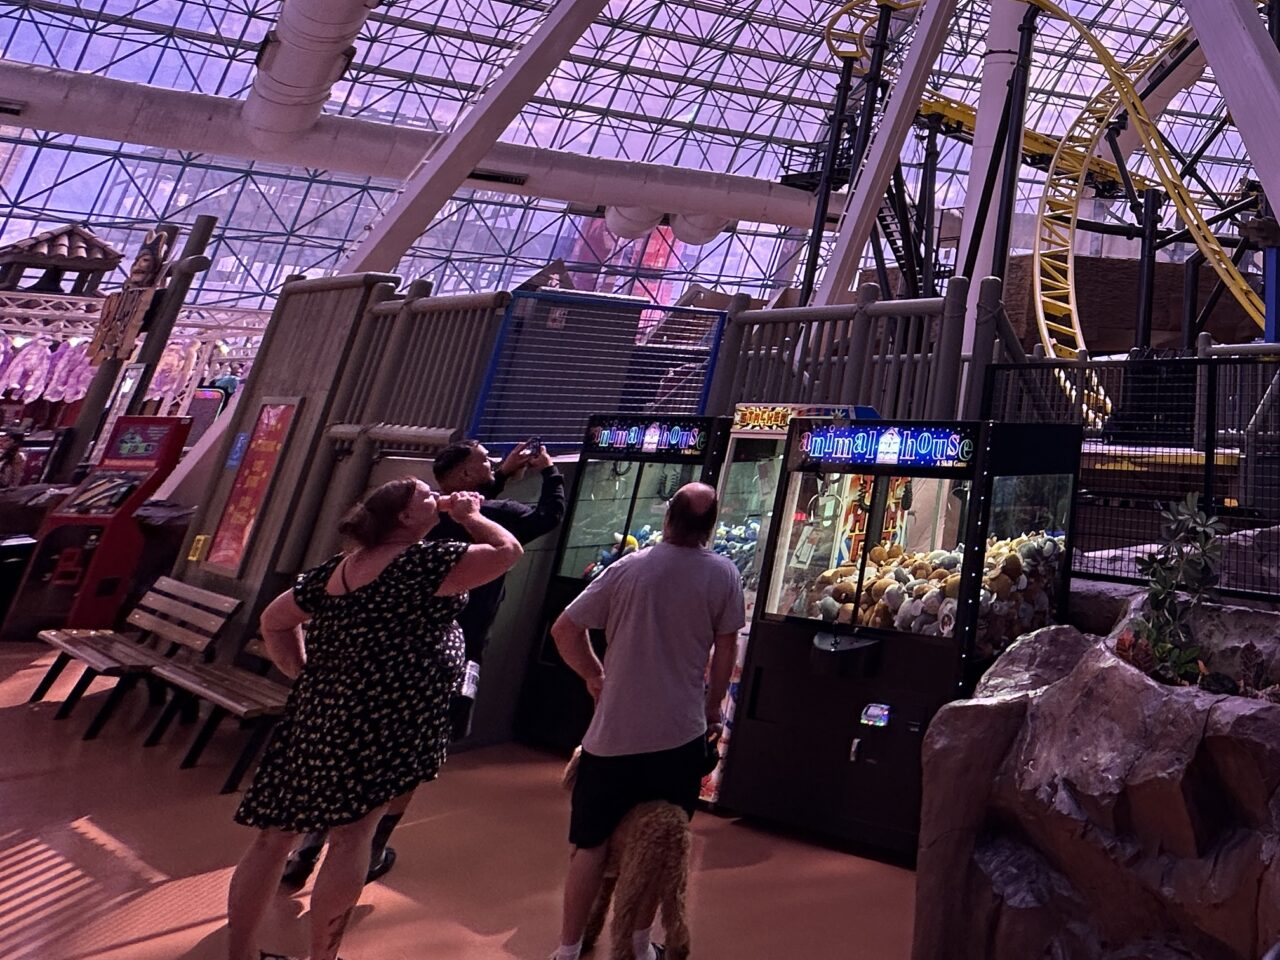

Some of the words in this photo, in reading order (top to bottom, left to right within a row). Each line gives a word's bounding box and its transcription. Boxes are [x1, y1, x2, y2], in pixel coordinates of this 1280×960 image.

[740, 410, 789, 426] STACKER
[658, 424, 708, 450] house
[799, 425, 876, 459] animal
[900, 431, 974, 460] house
